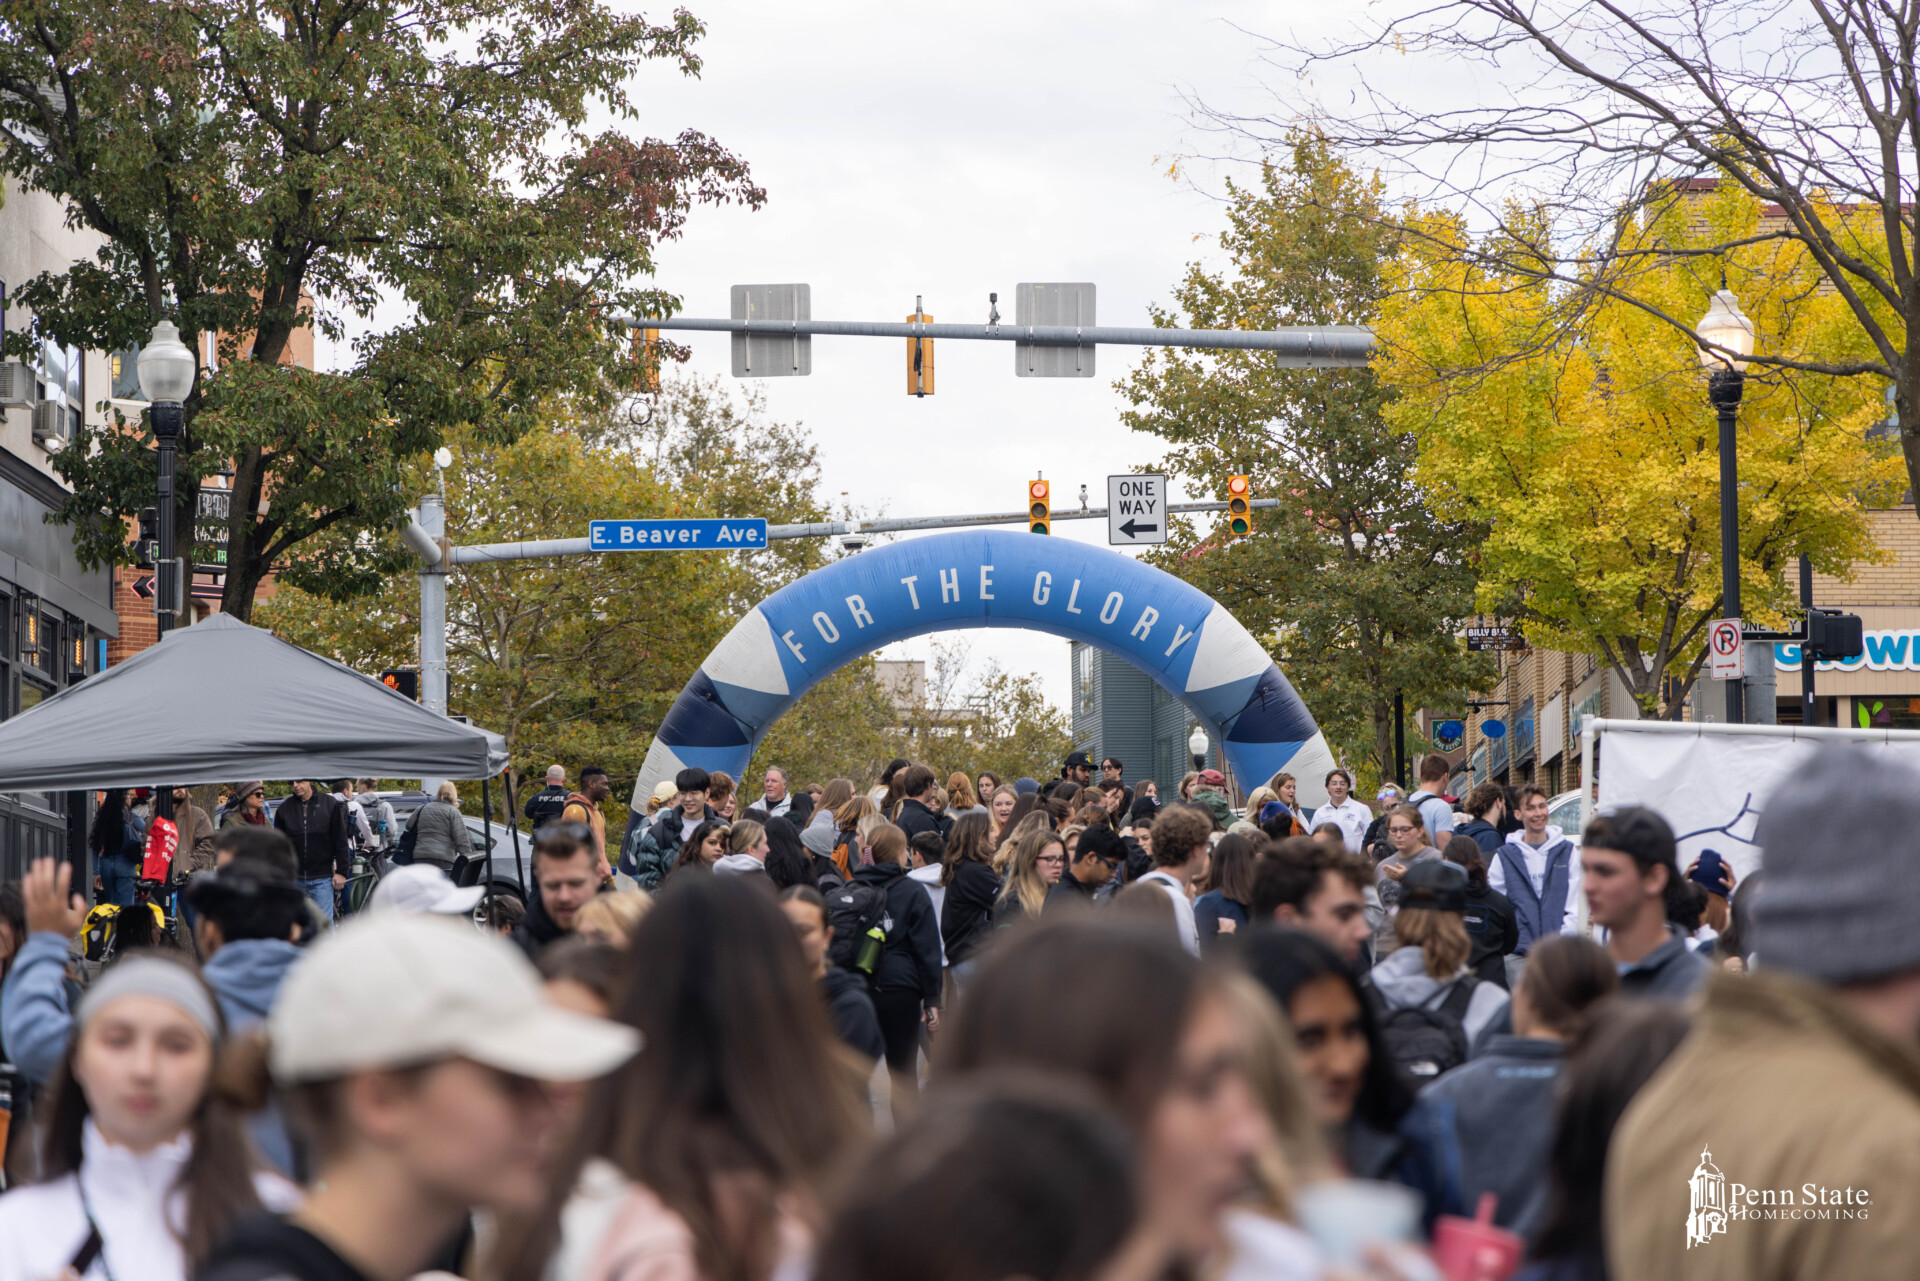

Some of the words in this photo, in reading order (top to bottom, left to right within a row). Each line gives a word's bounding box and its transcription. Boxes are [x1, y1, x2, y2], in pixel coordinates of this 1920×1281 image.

[1120, 481, 1155, 496] ONE
[1119, 499, 1156, 515] WAY
[592, 526, 612, 544] E.
[620, 526, 701, 544] Beaver
[716, 525, 764, 543] Ave.
[781, 594, 875, 664] FOR
[900, 565, 995, 610] THE
[1033, 571, 1193, 657] GLORY
[1468, 628, 1490, 637] BILLY
